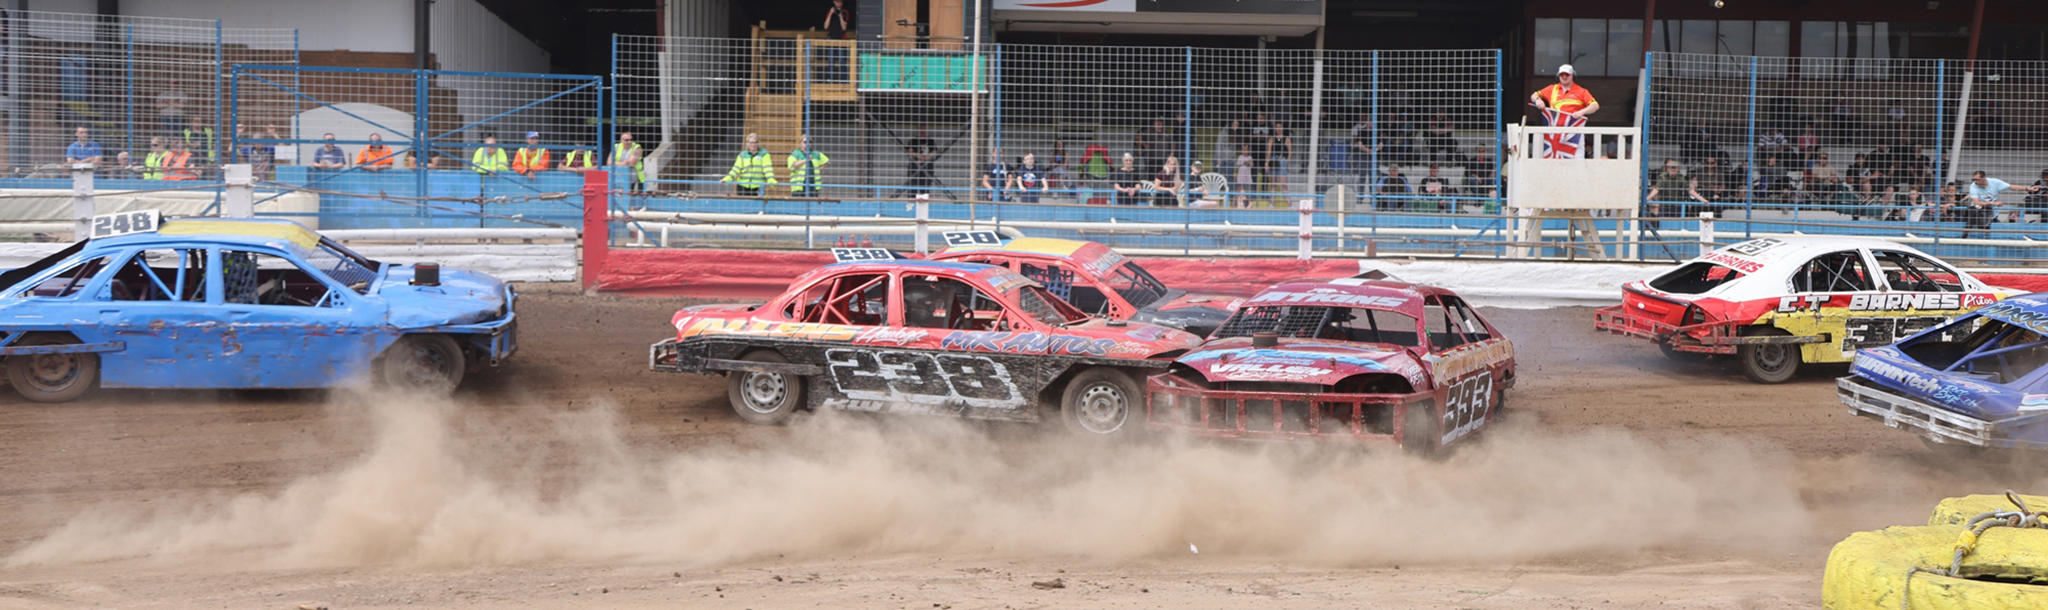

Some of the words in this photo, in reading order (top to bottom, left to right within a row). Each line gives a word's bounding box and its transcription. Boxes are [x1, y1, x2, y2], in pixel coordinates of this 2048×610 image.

[94, 211, 152, 237] 248
[835, 249, 890, 261] 238
[1248, 292, 1410, 308] ATKINS
[1848, 294, 1962, 311] BARNES
[1964, 294, 1994, 308] Autos
[681, 318, 863, 341] ALLENS
[941, 331, 1012, 351] MK
[1001, 331, 1117, 355] AUTOS
[824, 347, 1028, 410] 238
[1209, 363, 1334, 376] VALLEY
[1442, 371, 1493, 445] 393
